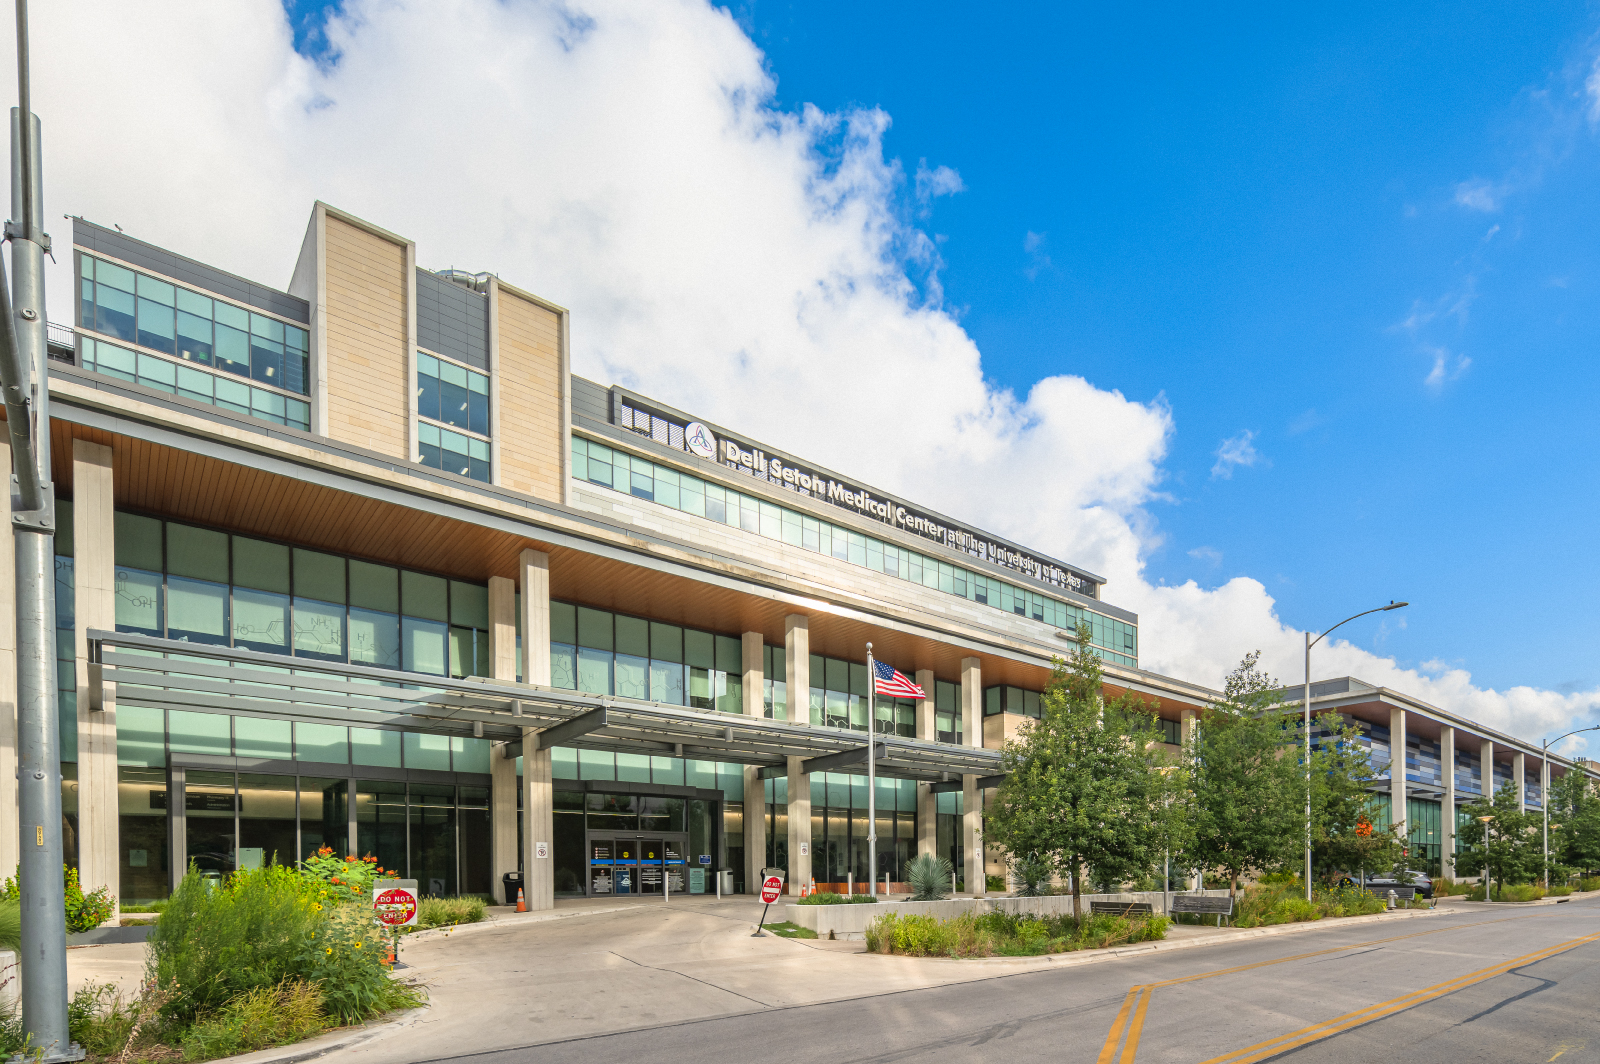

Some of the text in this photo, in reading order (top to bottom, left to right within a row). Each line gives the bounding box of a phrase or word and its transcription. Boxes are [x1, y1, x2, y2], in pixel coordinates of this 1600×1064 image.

[726, 440, 945, 537] Dell Seton Medical Center
[948, 530, 961, 545] at
[963, 532, 985, 553] The
[988, 542, 1040, 578] University
[1055, 567, 1081, 589] Texas
